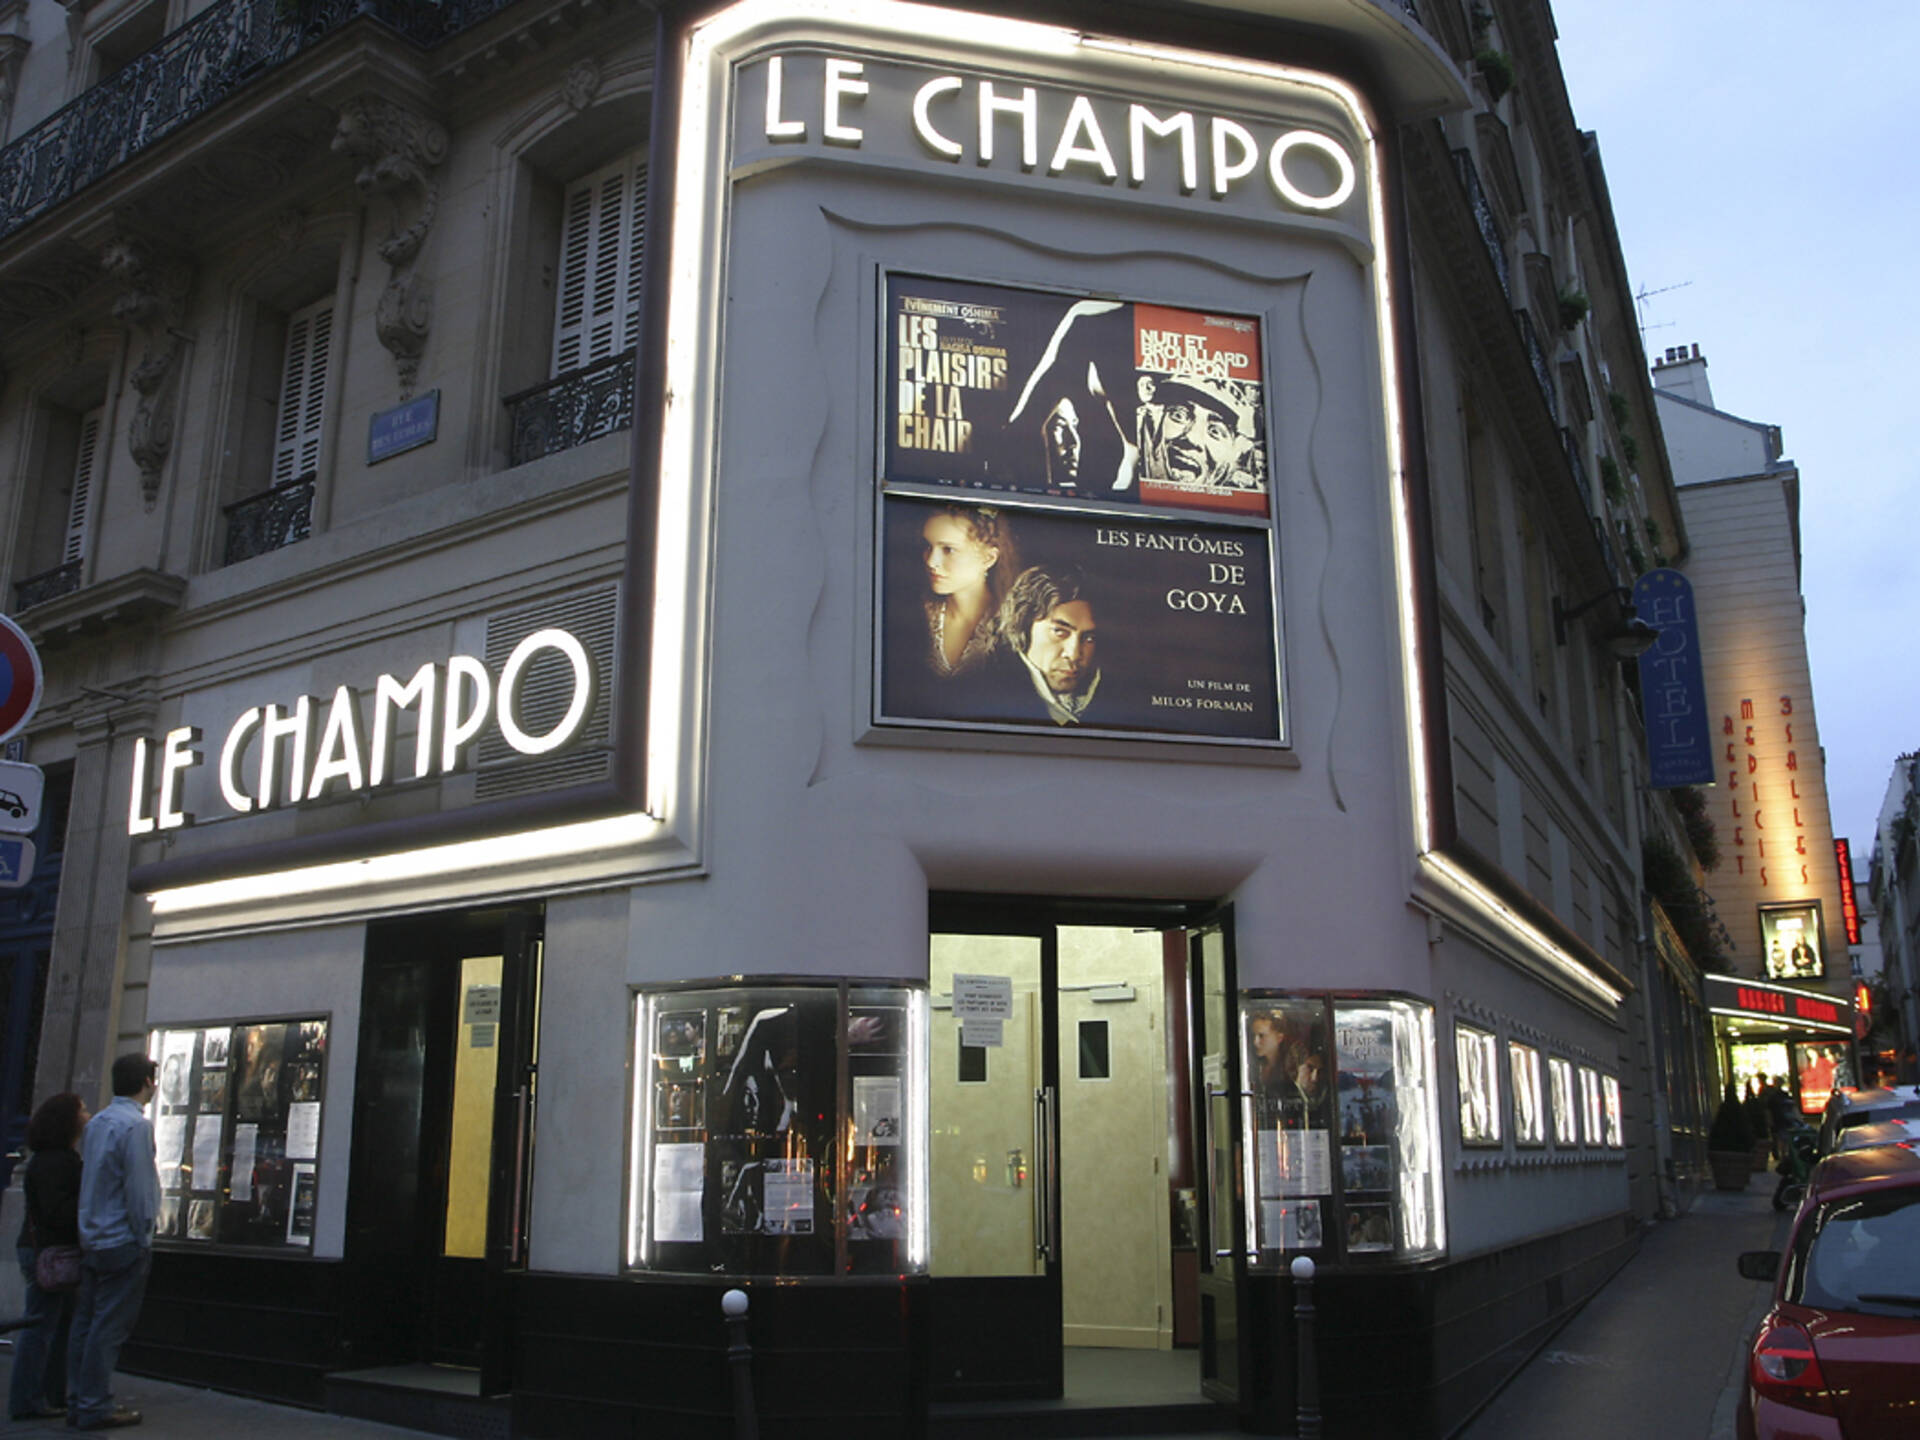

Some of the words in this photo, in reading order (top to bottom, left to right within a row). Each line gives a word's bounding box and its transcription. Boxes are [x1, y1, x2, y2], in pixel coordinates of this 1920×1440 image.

[766, 57, 869, 145] LE
[913, 76, 1355, 210] CHAMPO
[899, 314, 938, 350] LES
[1140, 329, 1182, 348] NUIT
[1184, 334, 1207, 350] ET
[899, 347, 1008, 391] PLAISIRS
[1141, 343, 1249, 368] BROUILLARD
[1142, 355, 1168, 373] AU
[1172, 357, 1229, 378] JAPON
[899, 380, 926, 417] DE
[935, 386, 963, 420] LA
[898, 414, 973, 453] CHAIR
[1097, 529, 1130, 547] LES
[1136, 533, 1244, 557] FANTÔMES
[1209, 563, 1246, 585] DE
[1167, 589, 1247, 615] GOYA
[1187, 680, 1205, 690] UN
[1208, 681, 1233, 691] FILM
[1236, 682, 1251, 692] DE
[1152, 695, 1193, 709] MILOS
[1197, 697, 1253, 712] FORMAN
[1779, 696, 1793, 716] 3
[129, 725, 202, 836] LE
[219, 628, 595, 812] CHAMPO
[1785, 722, 1808, 885] SALLES
